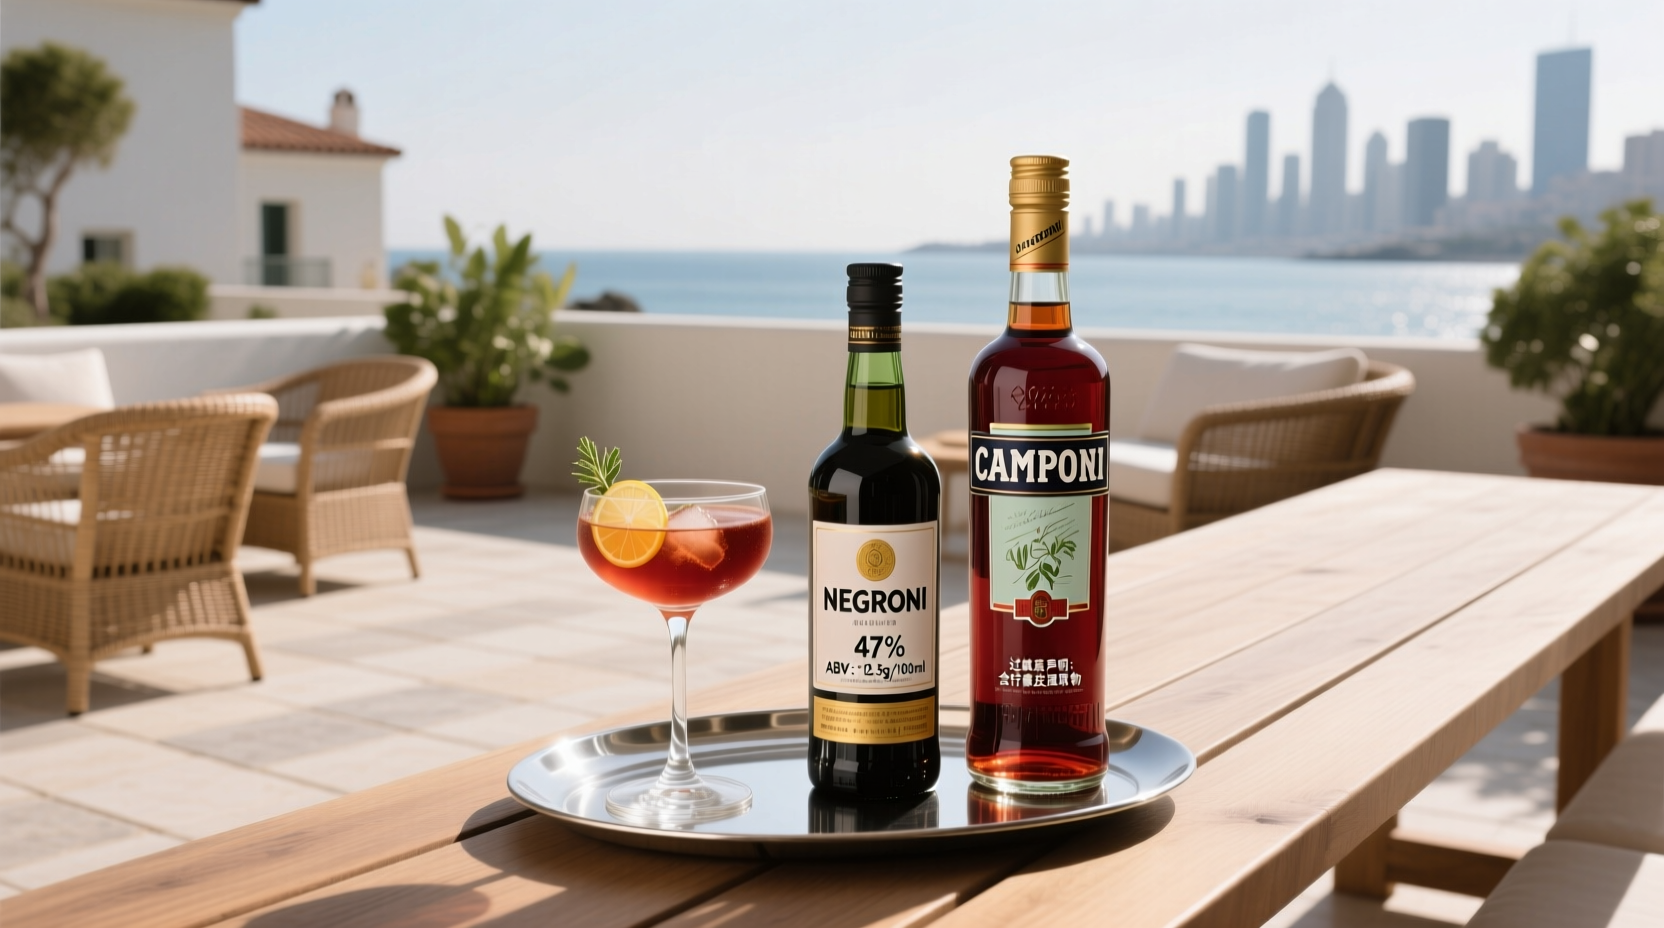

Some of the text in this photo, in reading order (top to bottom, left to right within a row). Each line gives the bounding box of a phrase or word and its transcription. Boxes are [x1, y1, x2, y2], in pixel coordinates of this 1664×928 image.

[975, 446, 1104, 483] CAMPONI
[824, 586, 927, 613] NEGRONI
[854, 634, 905, 659] 47%
